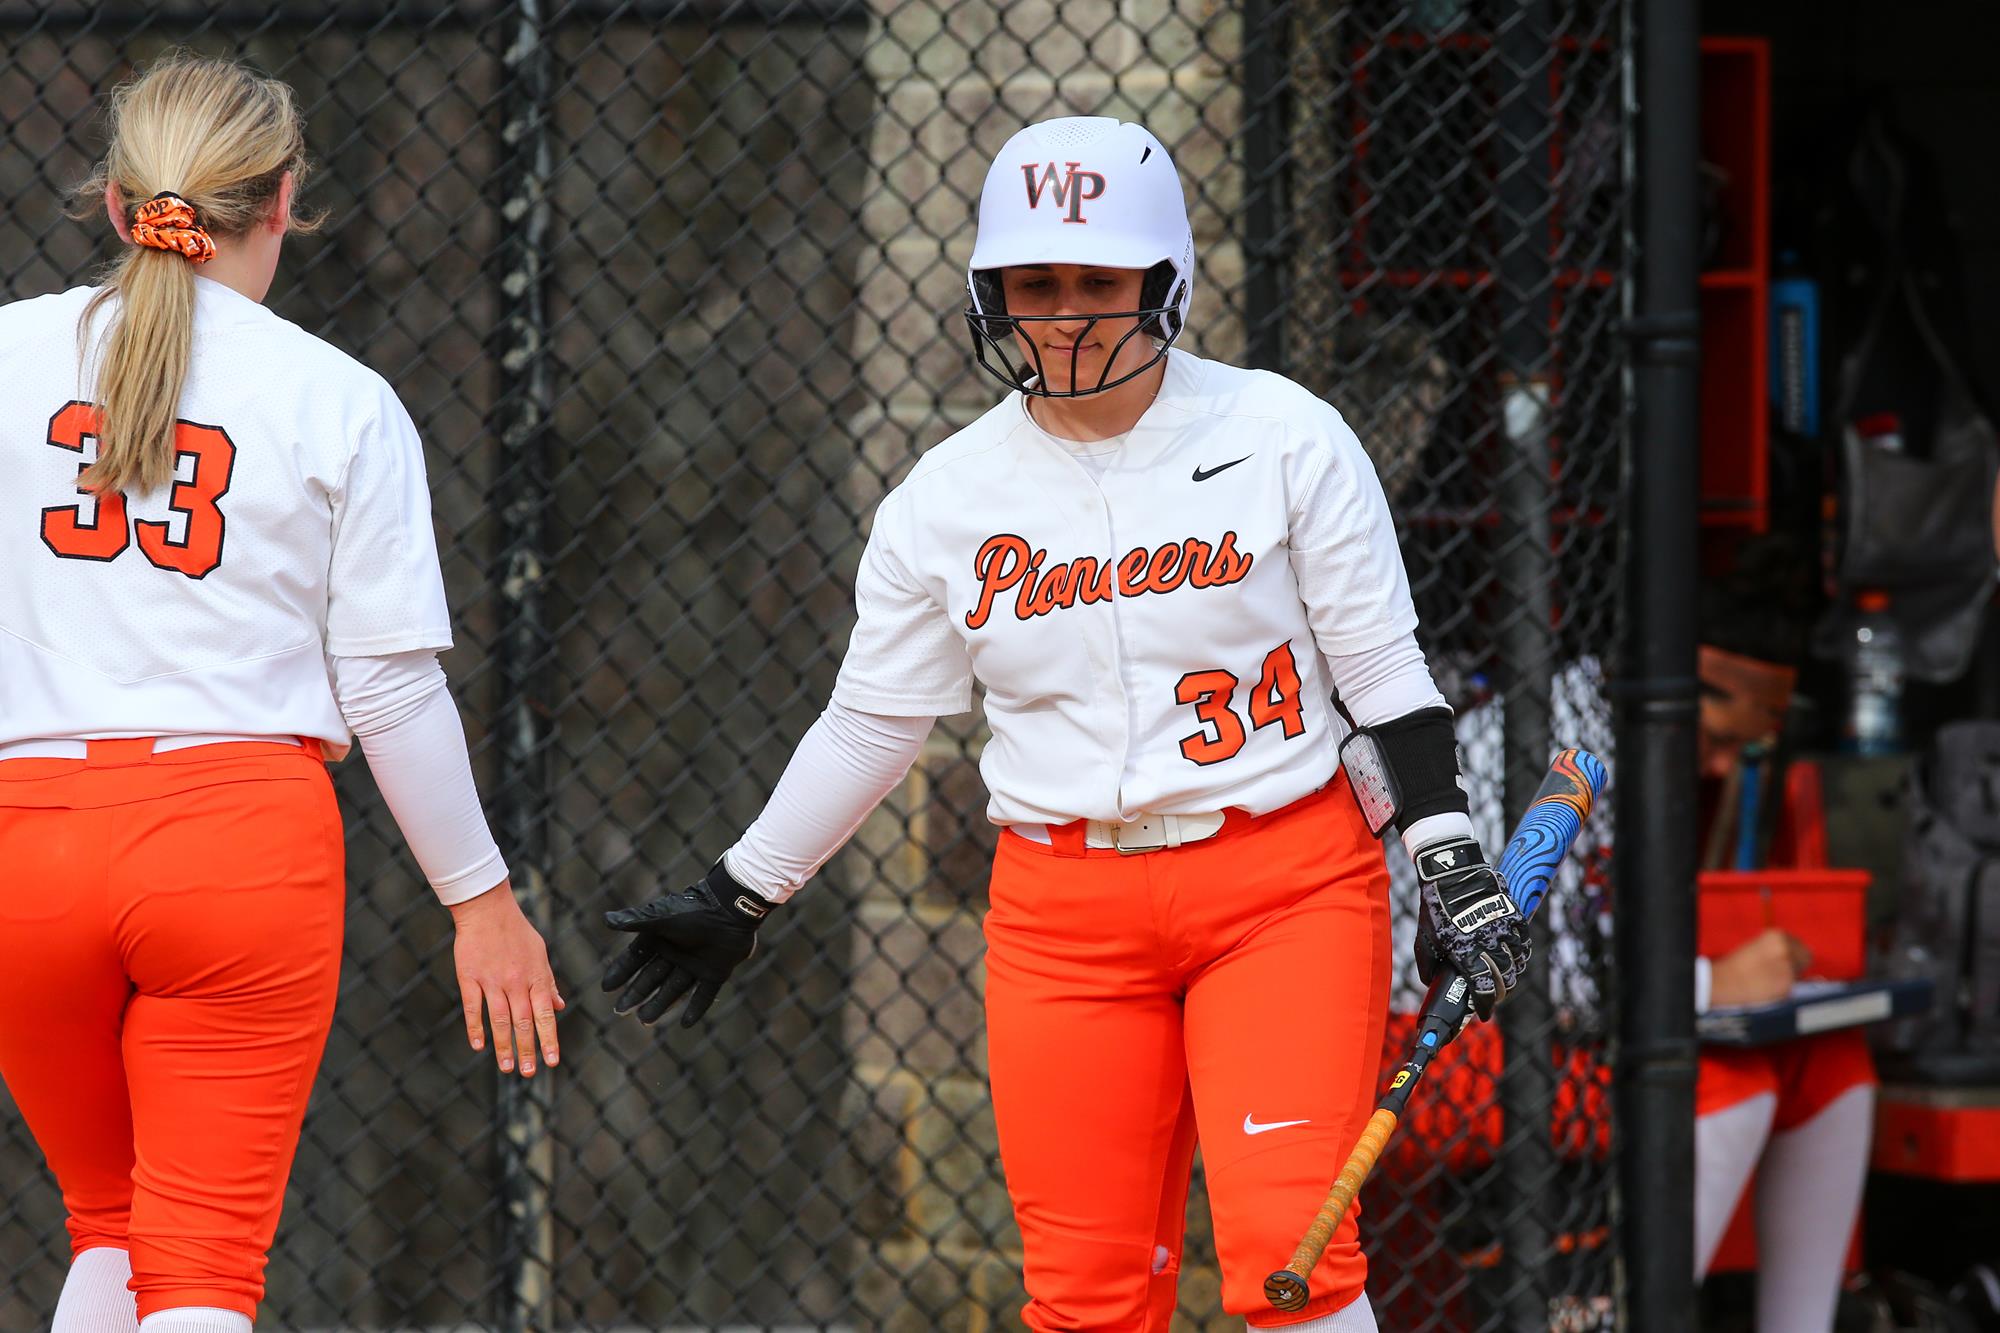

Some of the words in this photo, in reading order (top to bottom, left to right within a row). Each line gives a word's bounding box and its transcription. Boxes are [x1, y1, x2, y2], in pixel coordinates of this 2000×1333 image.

[143, 199, 169, 217] WP
[1021, 162, 1107, 225] WP
[40, 400, 237, 580] 33
[965, 531, 1254, 631] Pioneers
[1174, 638, 1307, 767] 34
[1456, 893, 1511, 930] franklin
